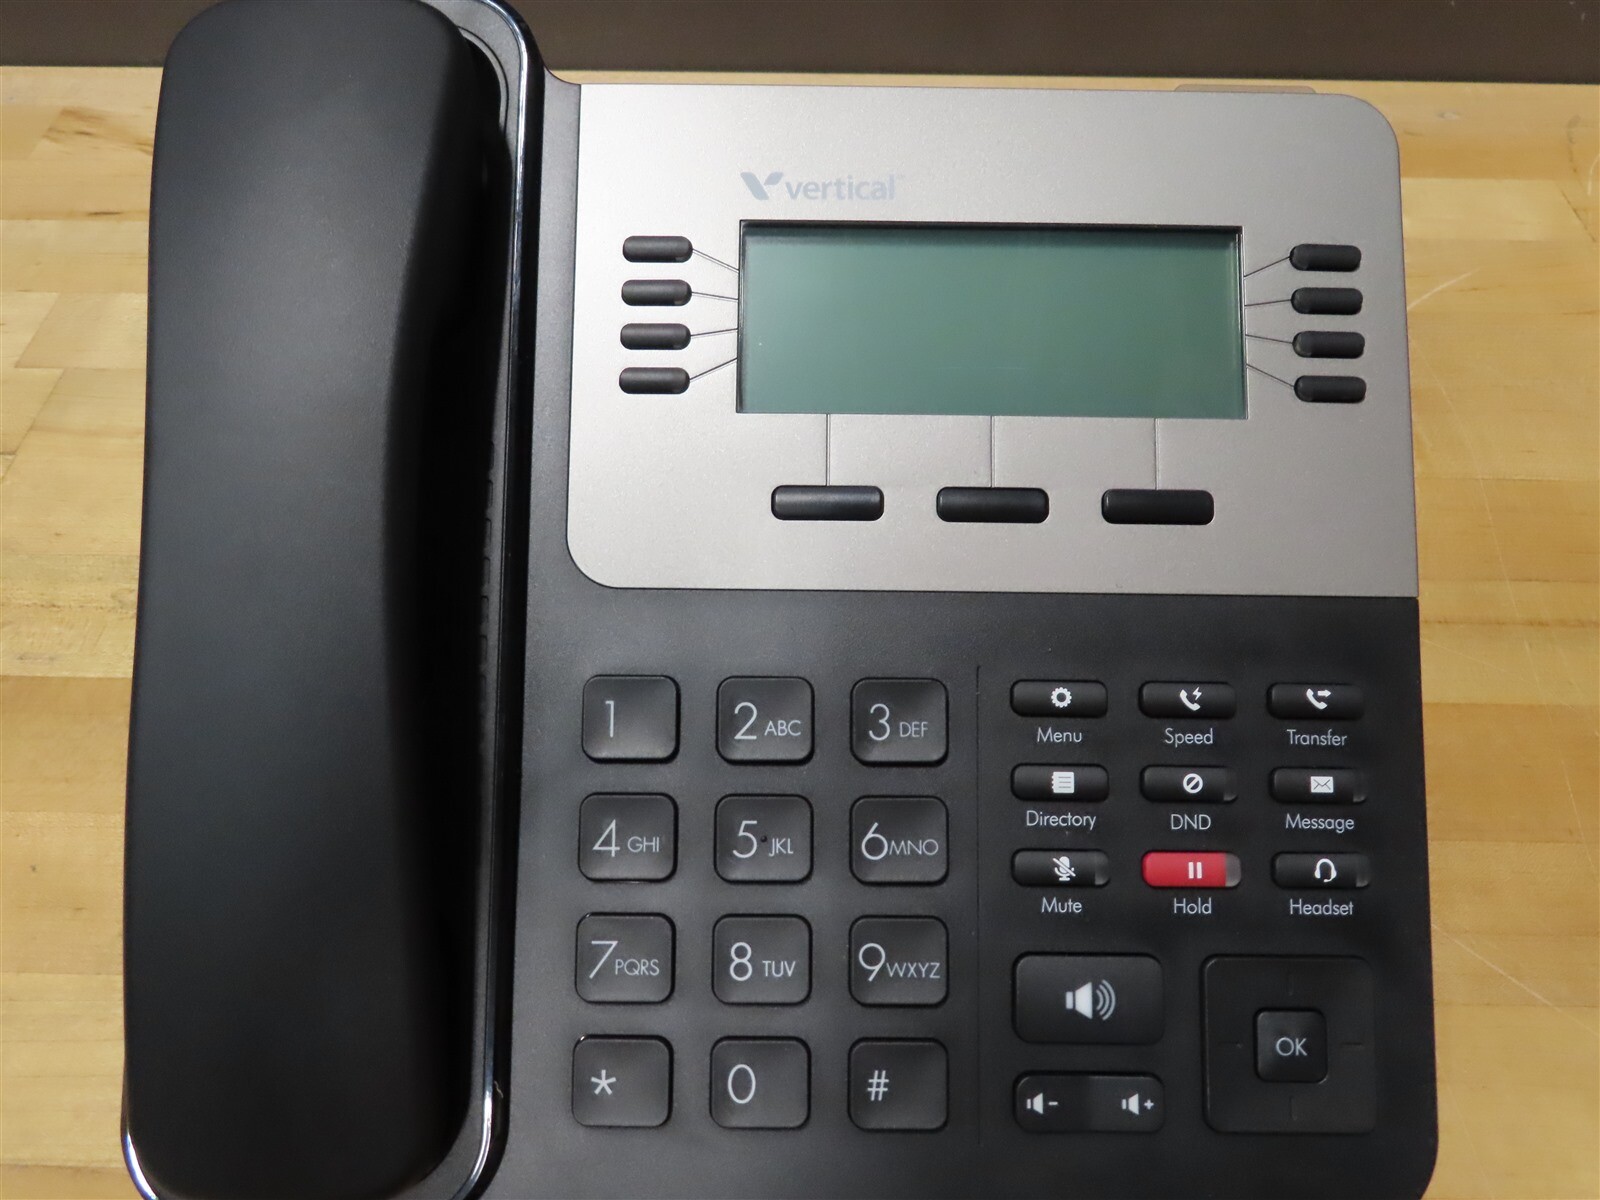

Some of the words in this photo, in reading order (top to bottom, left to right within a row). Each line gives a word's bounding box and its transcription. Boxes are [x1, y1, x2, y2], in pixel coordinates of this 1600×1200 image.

[784, 173, 896, 202] vertical
[605, 700, 615, 739] 1
[733, 701, 758, 741] 2
[763, 719, 802, 737] ABC
[868, 703, 891, 742] 3
[899, 721, 928, 738] DEF
[1036, 726, 1083, 743] Menu
[1164, 727, 1214, 748] Speed
[1286, 728, 1348, 746] Transfer
[1026, 809, 1097, 831] Directory
[1170, 813, 1212, 831] DND
[1285, 813, 1355, 834] Message
[592, 818, 621, 858] 4
[627, 835, 660, 853] GHI
[732, 820, 758, 859] 5
[768, 837, 794, 857] JKL
[861, 822, 889, 861] 6
[888, 838, 939, 856] MNO
[1041, 896, 1083, 914] Mute
[1173, 897, 1212, 915] Hold
[1289, 898, 1354, 916] Headset
[589, 939, 620, 980] 7
[614, 958, 660, 977] PQRS
[729, 941, 753, 982] 8
[761, 960, 796, 978] TUV
[858, 942, 886, 982] 9
[886, 961, 941, 979] WXYZ
[1275, 1036, 1308, 1057] OK
[866, 1069, 890, 1102] #
